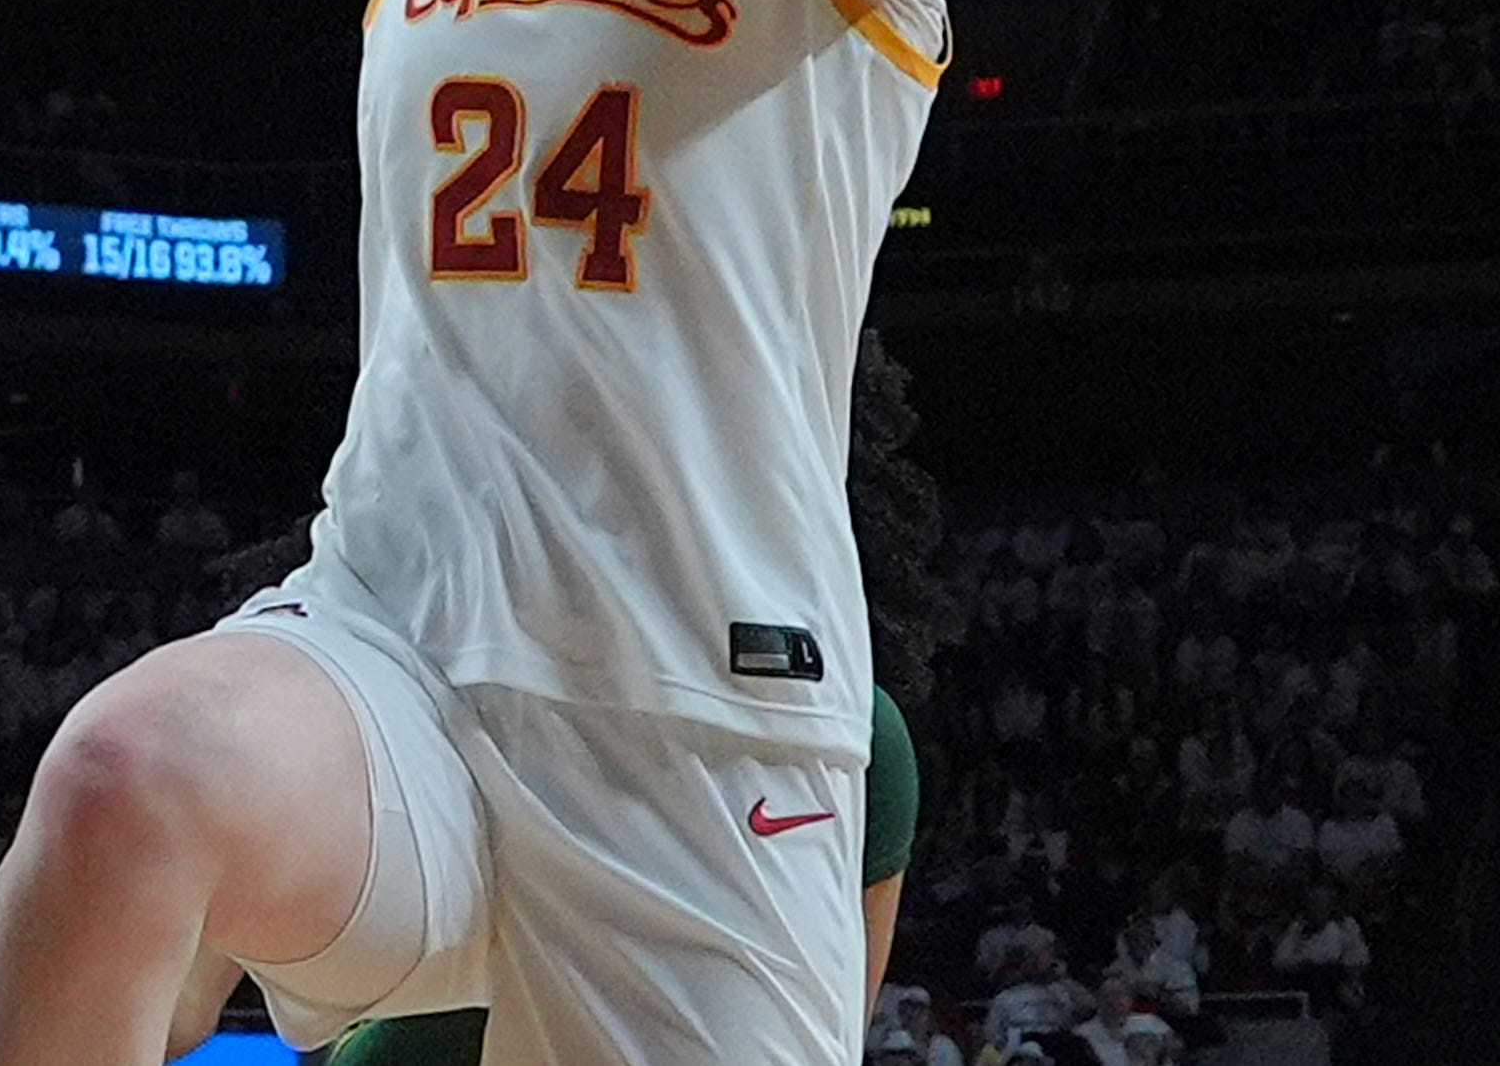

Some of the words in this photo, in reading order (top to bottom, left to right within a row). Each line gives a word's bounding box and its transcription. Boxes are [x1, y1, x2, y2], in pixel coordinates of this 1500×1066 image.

[428, 74, 654, 294] 24
[83, 233, 171, 280] 15/16
[173, 240, 273, 285] 93.8%
